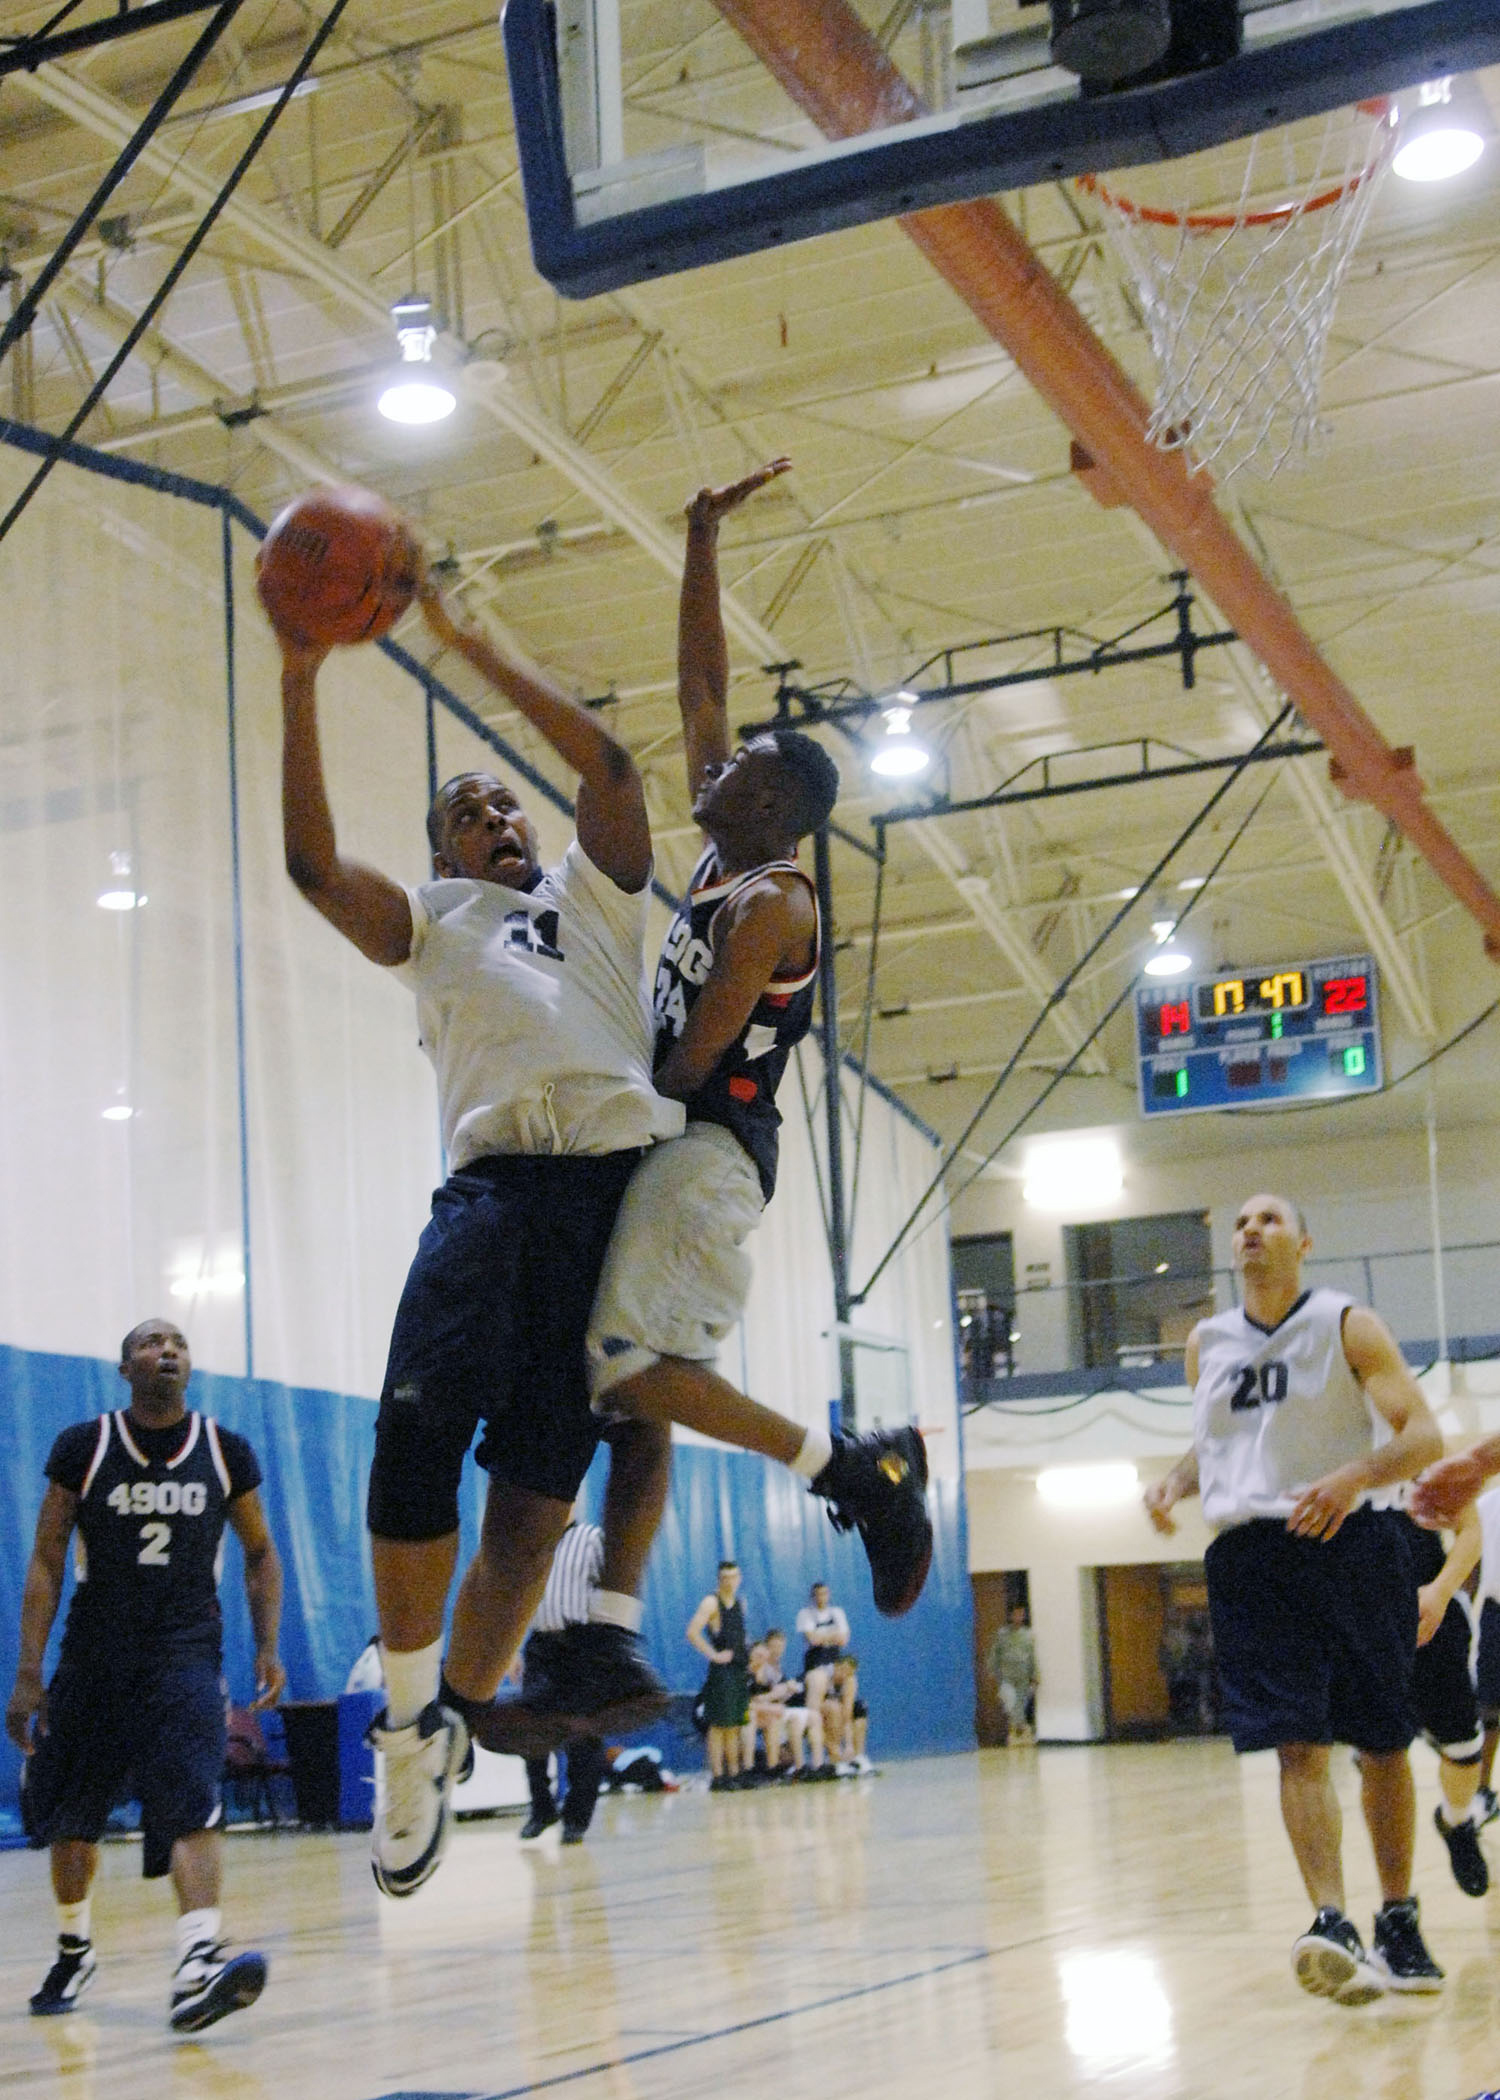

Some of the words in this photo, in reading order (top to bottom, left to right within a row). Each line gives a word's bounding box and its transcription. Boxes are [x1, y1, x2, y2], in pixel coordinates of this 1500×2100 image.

[1322, 976, 1367, 1014] 22
[1231, 1361, 1289, 1412] 20
[137, 1522, 173, 1565] 2
